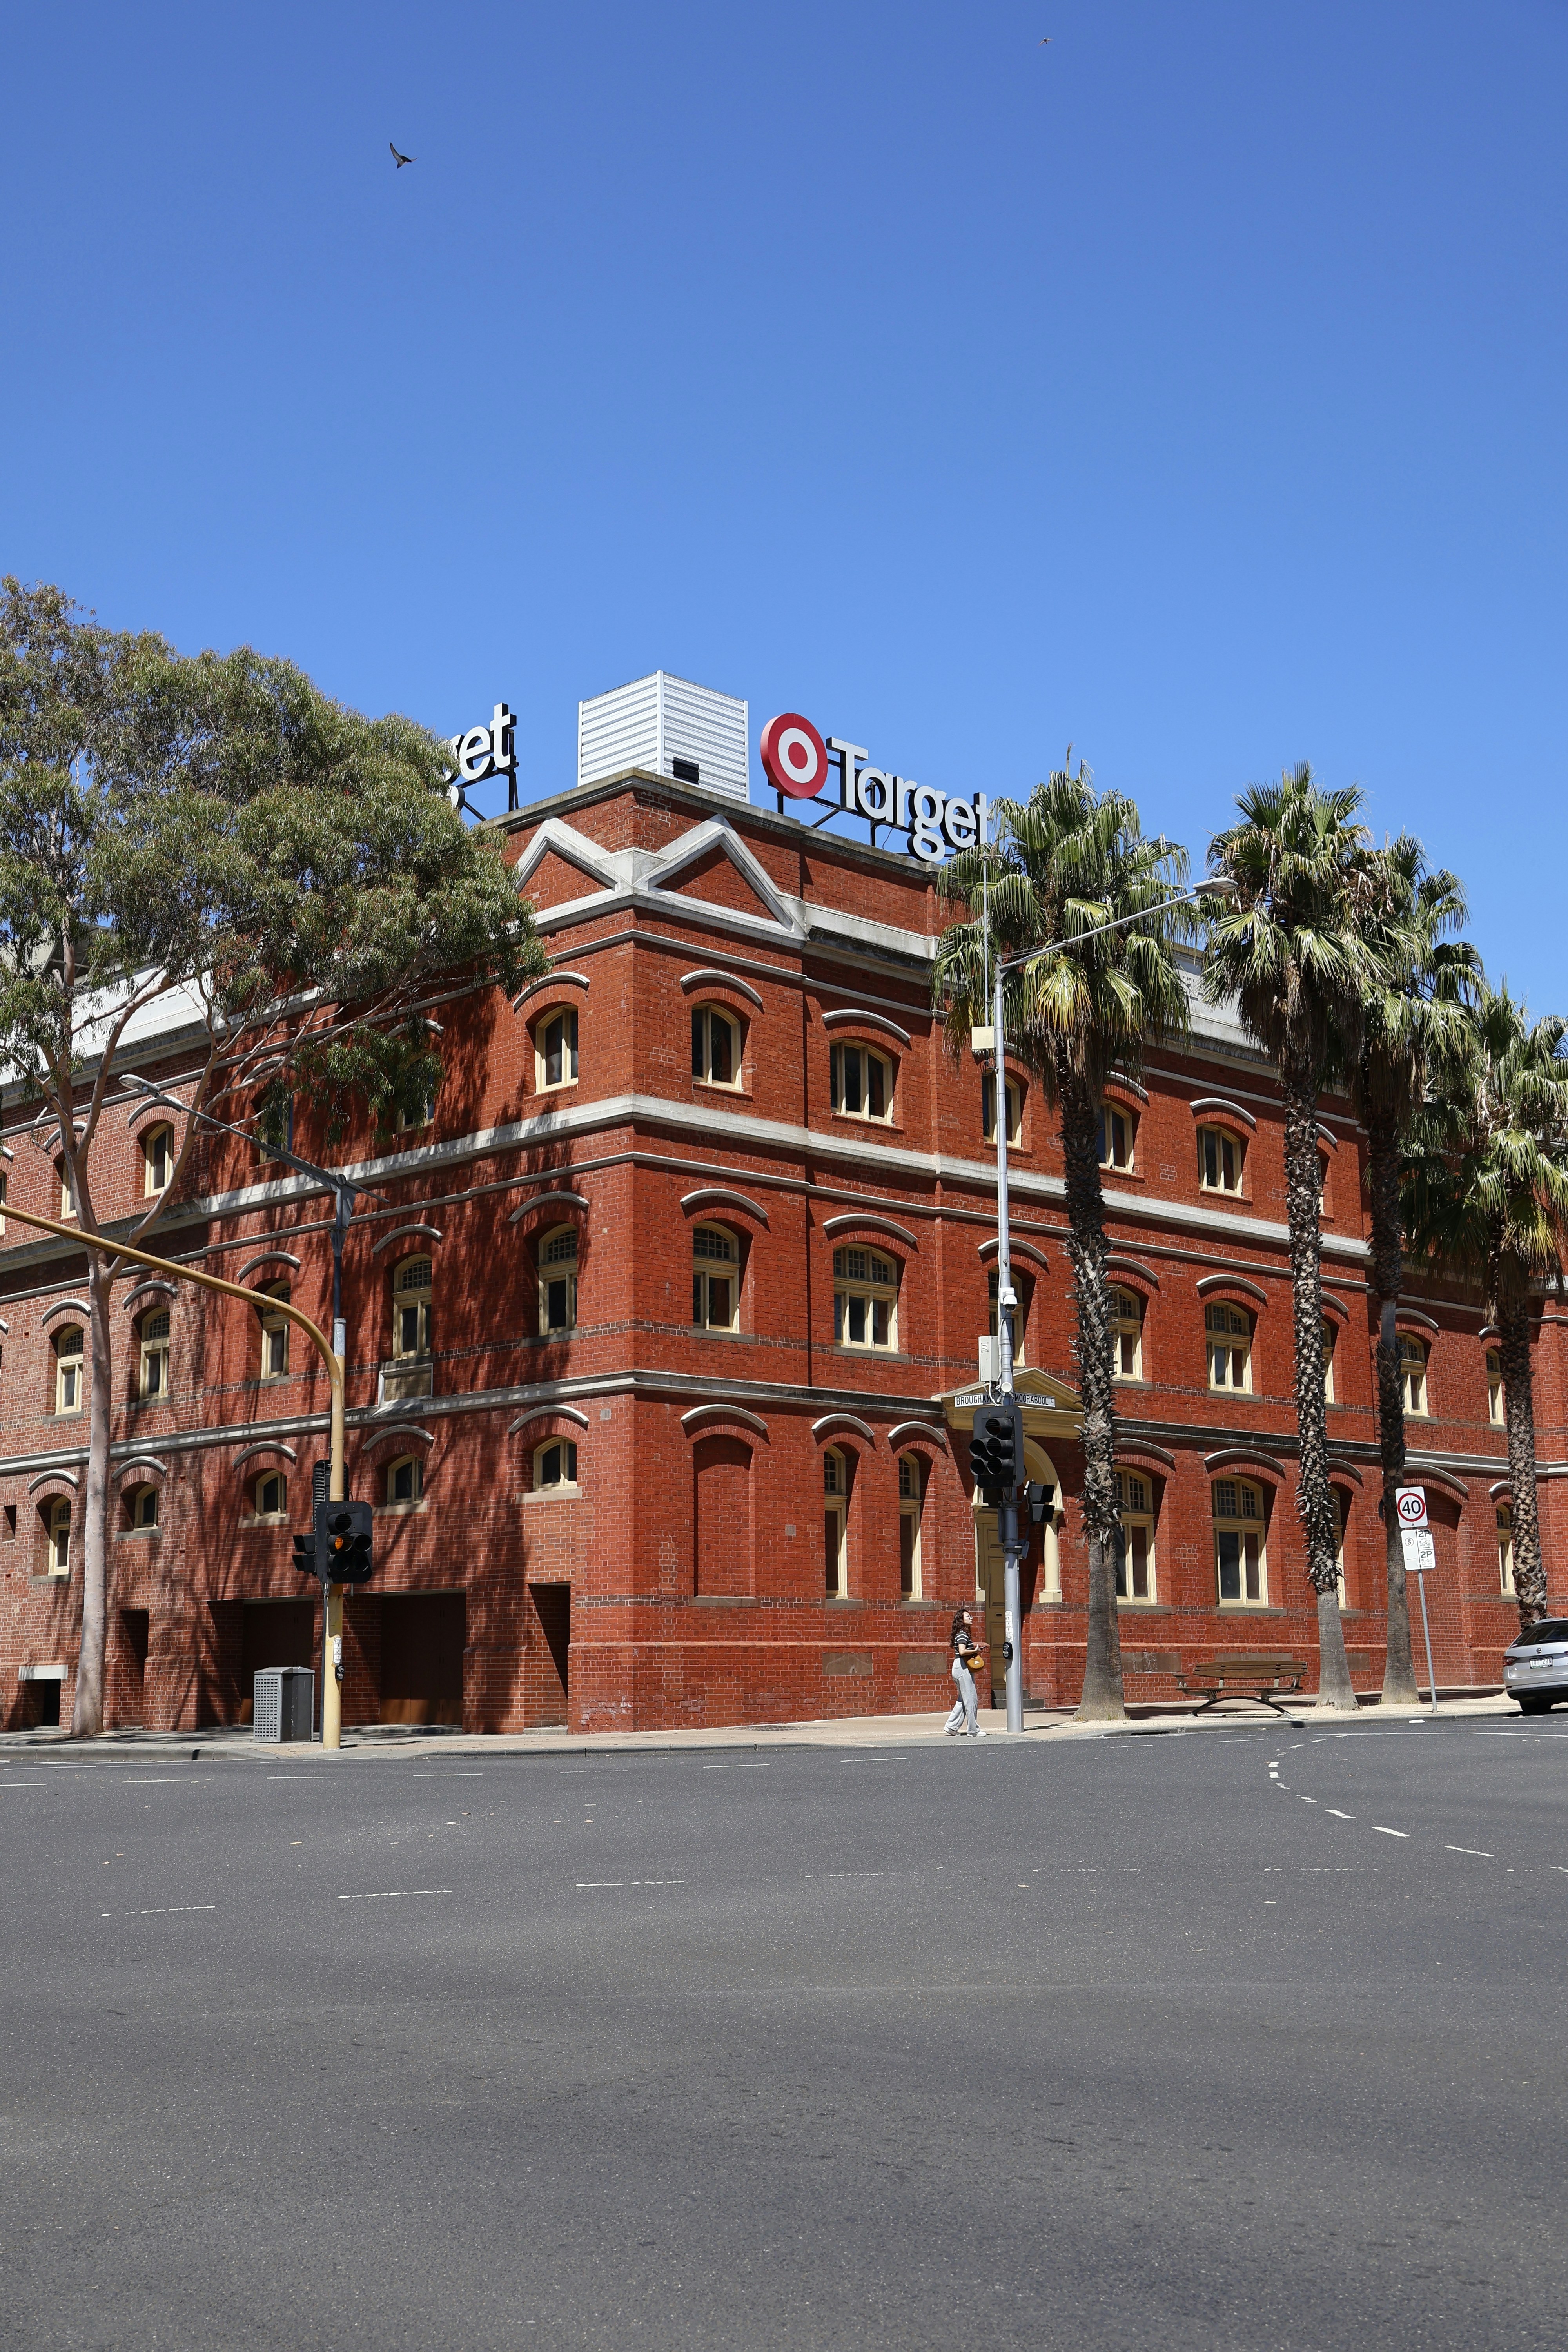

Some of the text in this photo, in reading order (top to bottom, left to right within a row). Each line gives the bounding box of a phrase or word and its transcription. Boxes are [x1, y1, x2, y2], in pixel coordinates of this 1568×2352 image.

[826, 737, 991, 862] Target
[956, 1394, 991, 1405] BROUGHAM
[1014, 1394, 1048, 1405] MOORABOOL
[1402, 1500, 1421, 1514] 40
